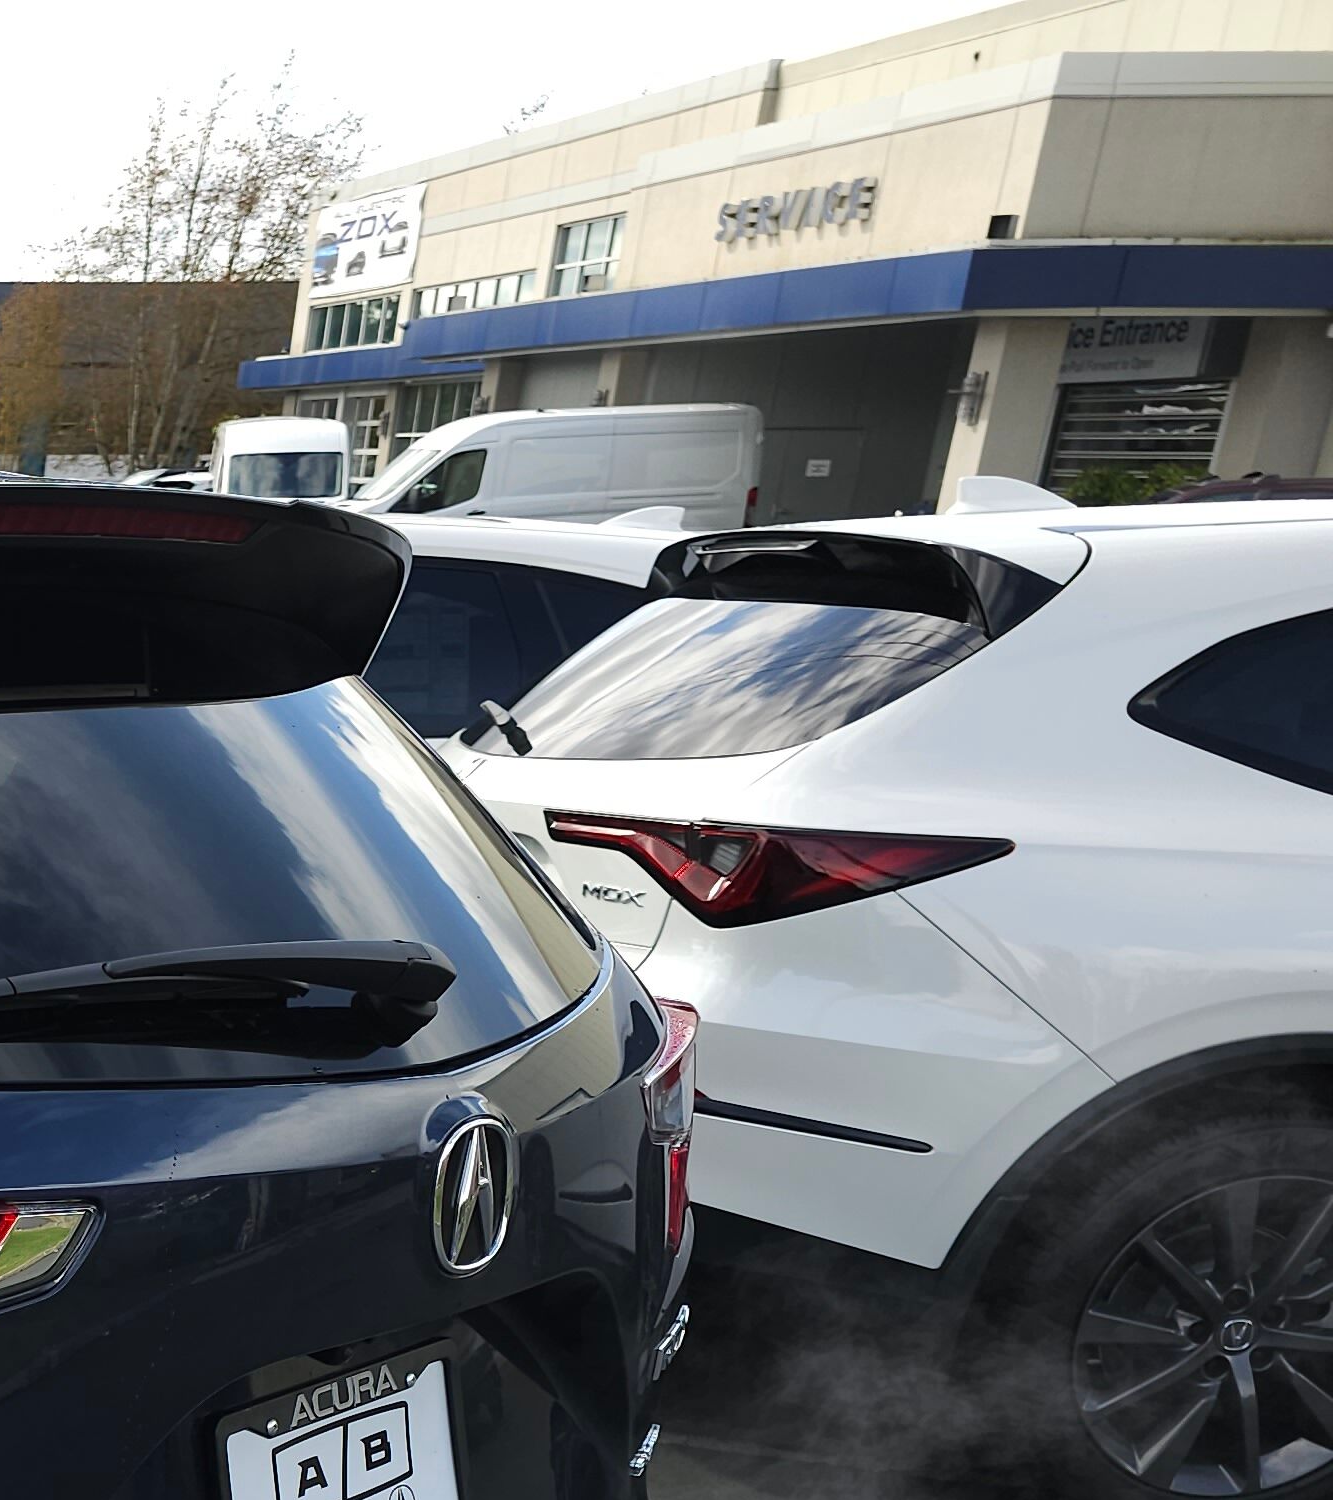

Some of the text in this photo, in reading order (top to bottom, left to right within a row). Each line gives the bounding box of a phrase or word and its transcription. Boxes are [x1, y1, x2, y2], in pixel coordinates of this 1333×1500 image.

[715, 176, 878, 243] SERVICE
[1099, 320, 1189, 347] Entrance
[583, 883, 647, 908] MDX
[290, 1364, 397, 1430] ACURA
[297, 1429, 392, 1499] A B
